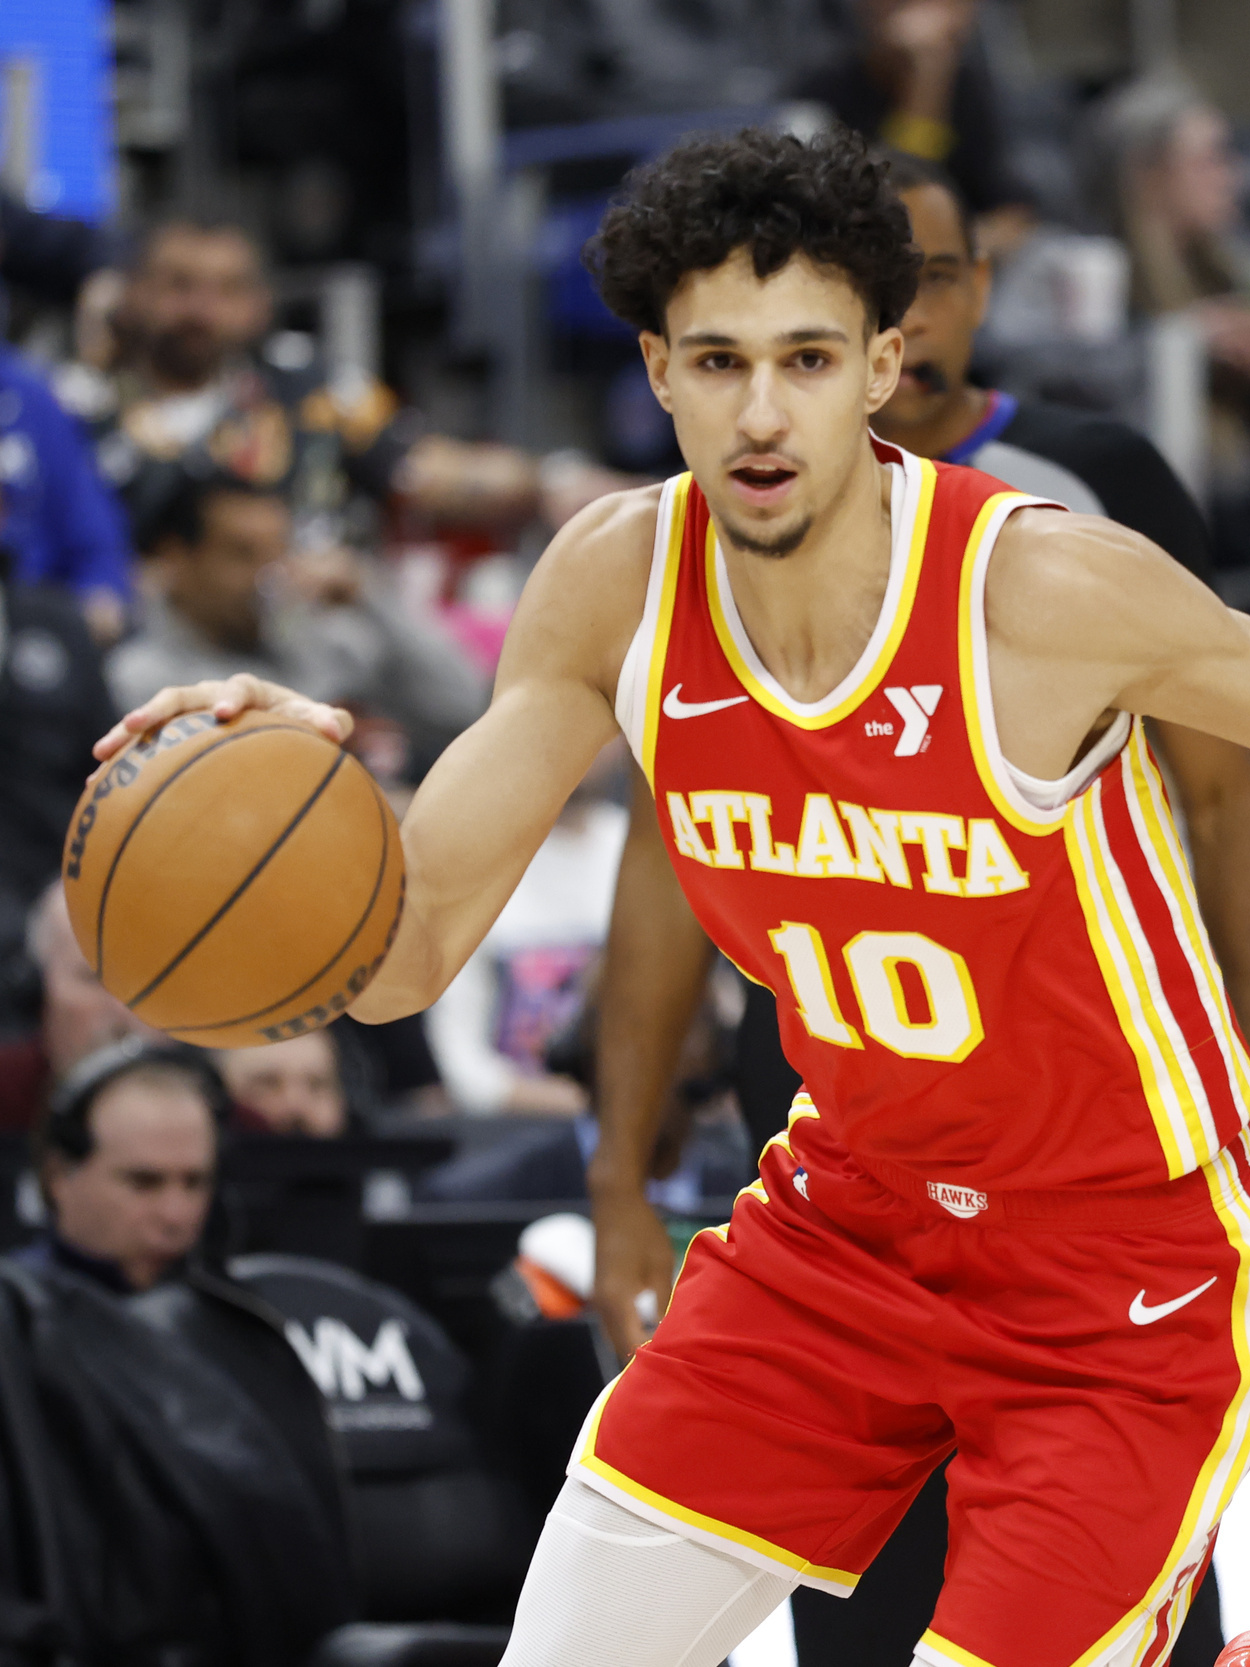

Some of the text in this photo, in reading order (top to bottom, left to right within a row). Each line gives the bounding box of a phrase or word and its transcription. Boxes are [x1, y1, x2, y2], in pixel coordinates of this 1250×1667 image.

[864, 684, 944, 757] the Y
[666, 790, 1030, 898] ATLANTA
[767, 920, 985, 1064] 10
[927, 1182, 988, 1210] HAWKS
